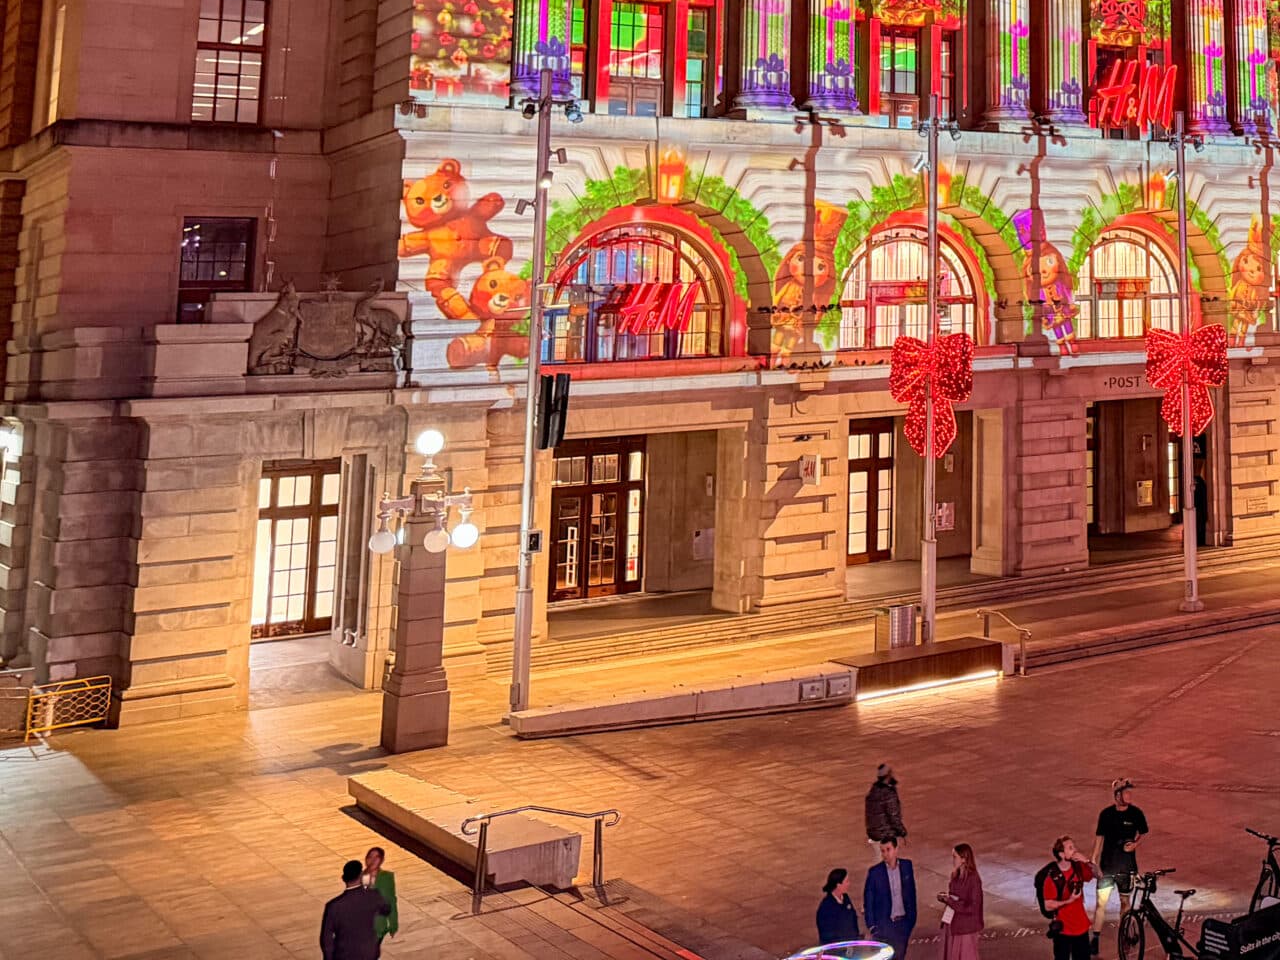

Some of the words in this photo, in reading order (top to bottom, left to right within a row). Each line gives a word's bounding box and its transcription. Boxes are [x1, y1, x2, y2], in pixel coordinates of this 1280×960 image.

[1097, 58, 1178, 130] H&M
[619, 280, 701, 335] H&M
[1109, 376, 1141, 389] POST
[1240, 943, 1254, 954] Suits
[1262, 935, 1271, 945] the
